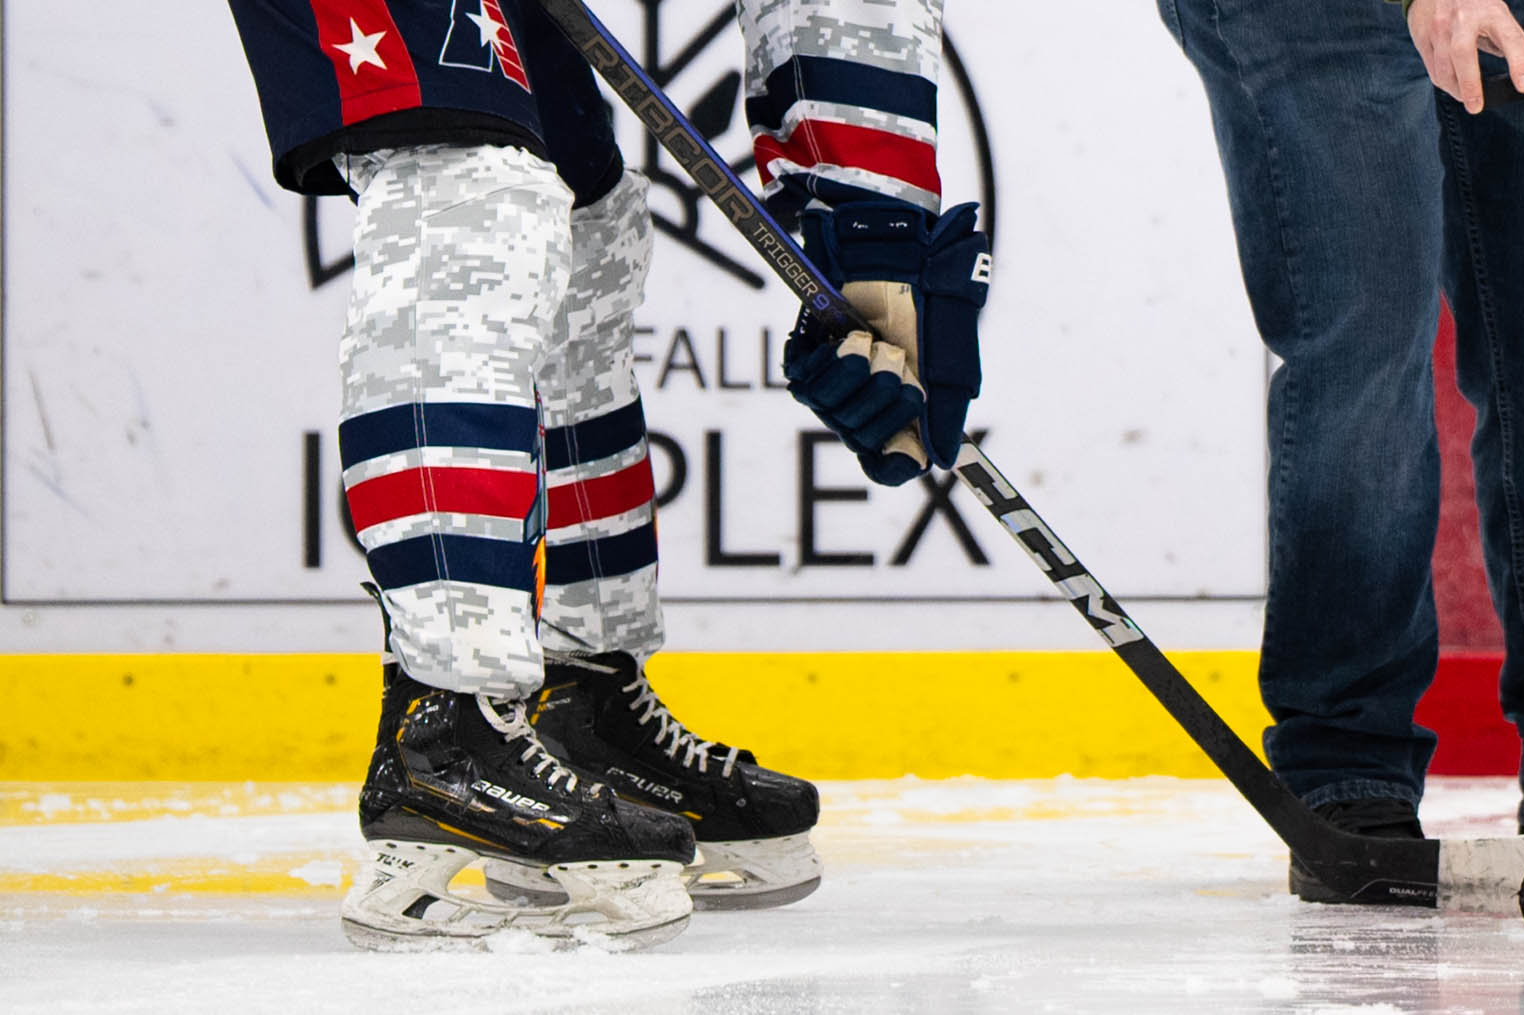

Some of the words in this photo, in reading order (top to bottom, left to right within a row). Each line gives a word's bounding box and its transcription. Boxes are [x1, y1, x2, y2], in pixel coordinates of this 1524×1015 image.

[583, 34, 755, 223] RIBCOR
[752, 222, 819, 298] TRIGGER
[633, 327, 790, 390] ALL
[955, 442, 1145, 649] CCM
